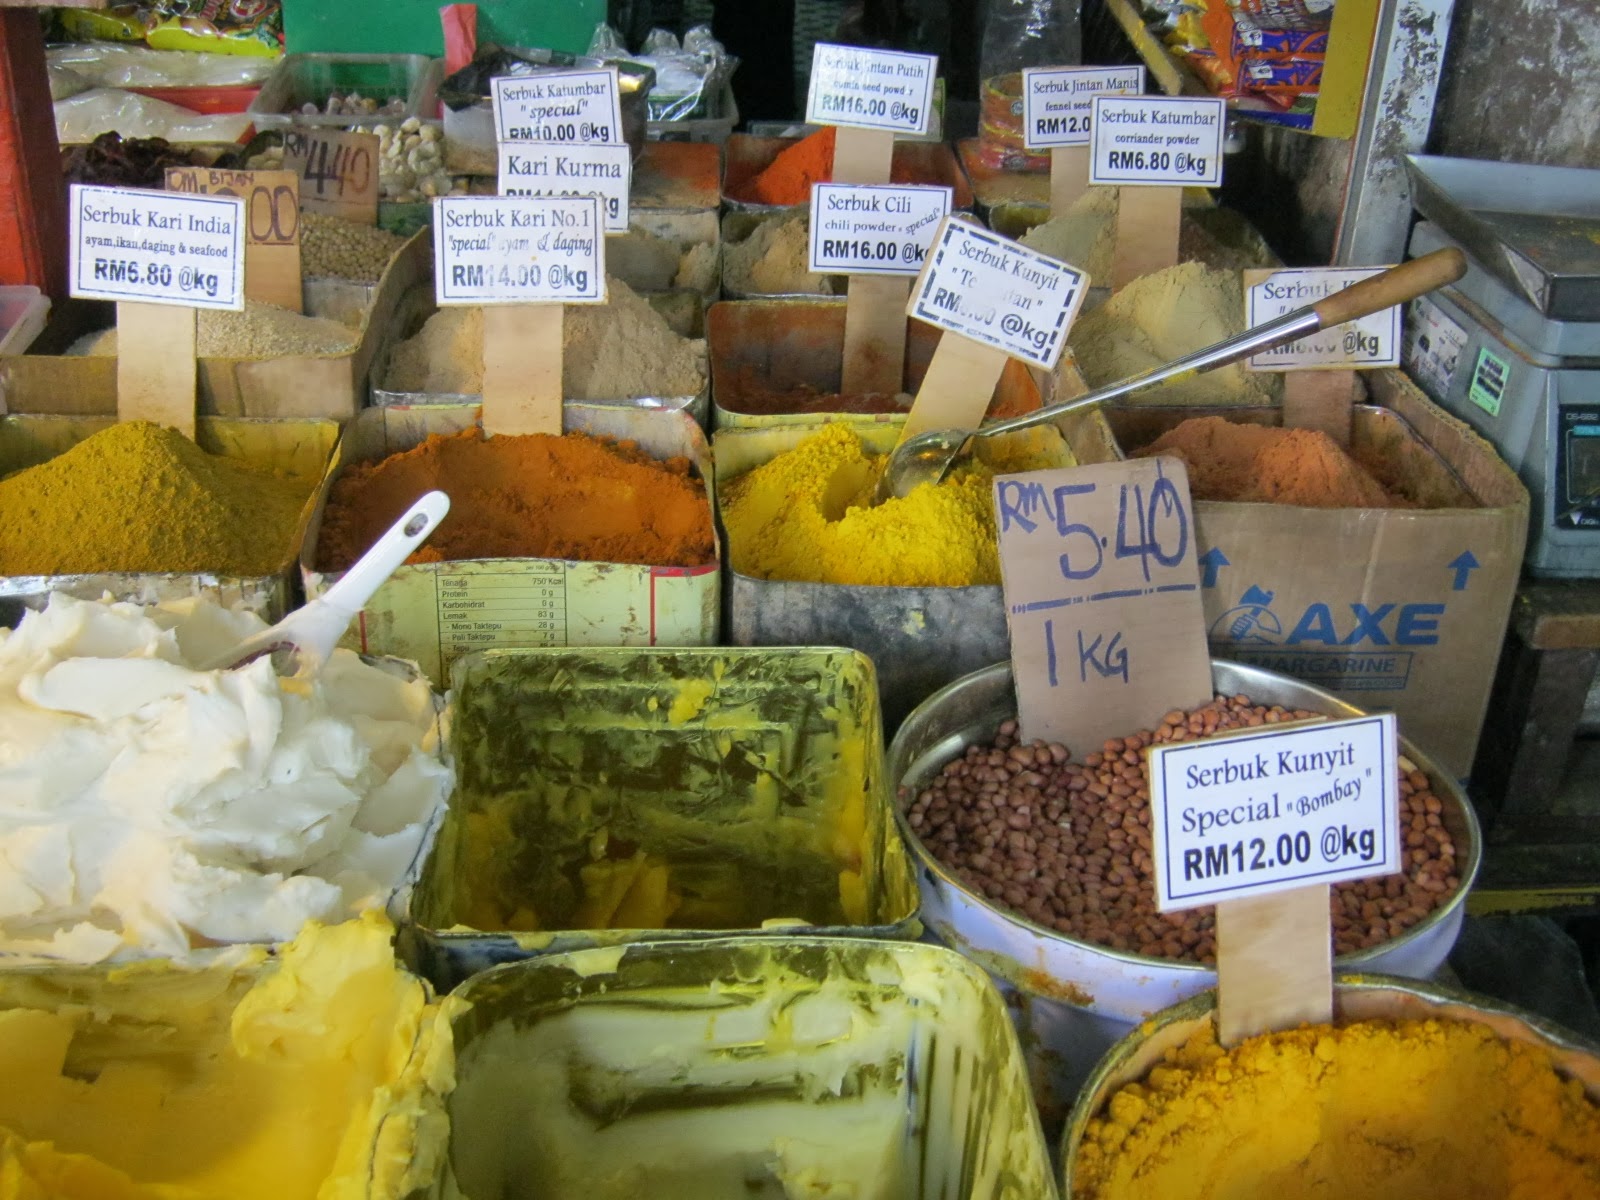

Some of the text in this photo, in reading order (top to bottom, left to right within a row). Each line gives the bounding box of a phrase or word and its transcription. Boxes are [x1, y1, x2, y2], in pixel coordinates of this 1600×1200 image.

[823, 55, 924, 78] Sruk ntan Putih
[503, 81, 606, 100] Serbuk Katumbar
[863, 83, 881, 92] seed
[883, 85, 913, 96] powdr
[1033, 76, 1138, 95] Serbuk Jintan Manis
[822, 94, 919, 124] RM16.00 @kg
[1045, 101, 1072, 111] fennel
[1101, 109, 1216, 126] Serbuk Katumbar
[510, 122, 609, 142] RM10.00 @kg
[1115, 133, 1200, 147] corriander powder
[508, 155, 621, 178] Kari Kurma
[1109, 151, 1207, 176] RM6.80 @kg
[827, 194, 912, 214] Serbuk Cili
[83, 205, 231, 235] Serbuk Kari India
[446, 209, 590, 227] Serbuk Kari No.1
[825, 219, 850, 232] chili
[853, 220, 896, 234] powder
[178, 245, 186, 253] &
[189, 245, 228, 257] seafood
[500, 238, 529, 256] yam
[552, 232, 593, 257] daging
[823, 240, 897, 260] RM16.00
[959, 239, 1060, 291] Serbuk Kunyit
[94, 258, 218, 297] RM6.80 @kg
[452, 264, 588, 292] RM14.00 @kg
[1264, 279, 1334, 300] Serbuk
[1000, 313, 1049, 349] @kg
[1342, 331, 1379, 356] @kg
[442, 579, 468, 588] Tenaga
[548, 577, 564, 585] Kcal
[442, 590, 468, 598] Protein
[442, 600, 485, 609] Karbohidrat
[443, 612, 467, 620] Lemak
[537, 610, 548, 618] 83
[1285, 602, 1446, 645] AXE
[451, 622, 472, 631] Mono
[473, 622, 502, 630] Taktepu
[538, 621, 548, 629] 28
[452, 633, 466, 641] Poli
[467, 633, 496, 641] Taktepu
[453, 644, 470, 653] Tepu
[1044, 619, 1129, 687] 1 KG
[1186, 742, 1356, 790] Serbuk Kunyit
[1182, 793, 1281, 837] Special
[1184, 824, 1376, 882] RM12.00 @kg
